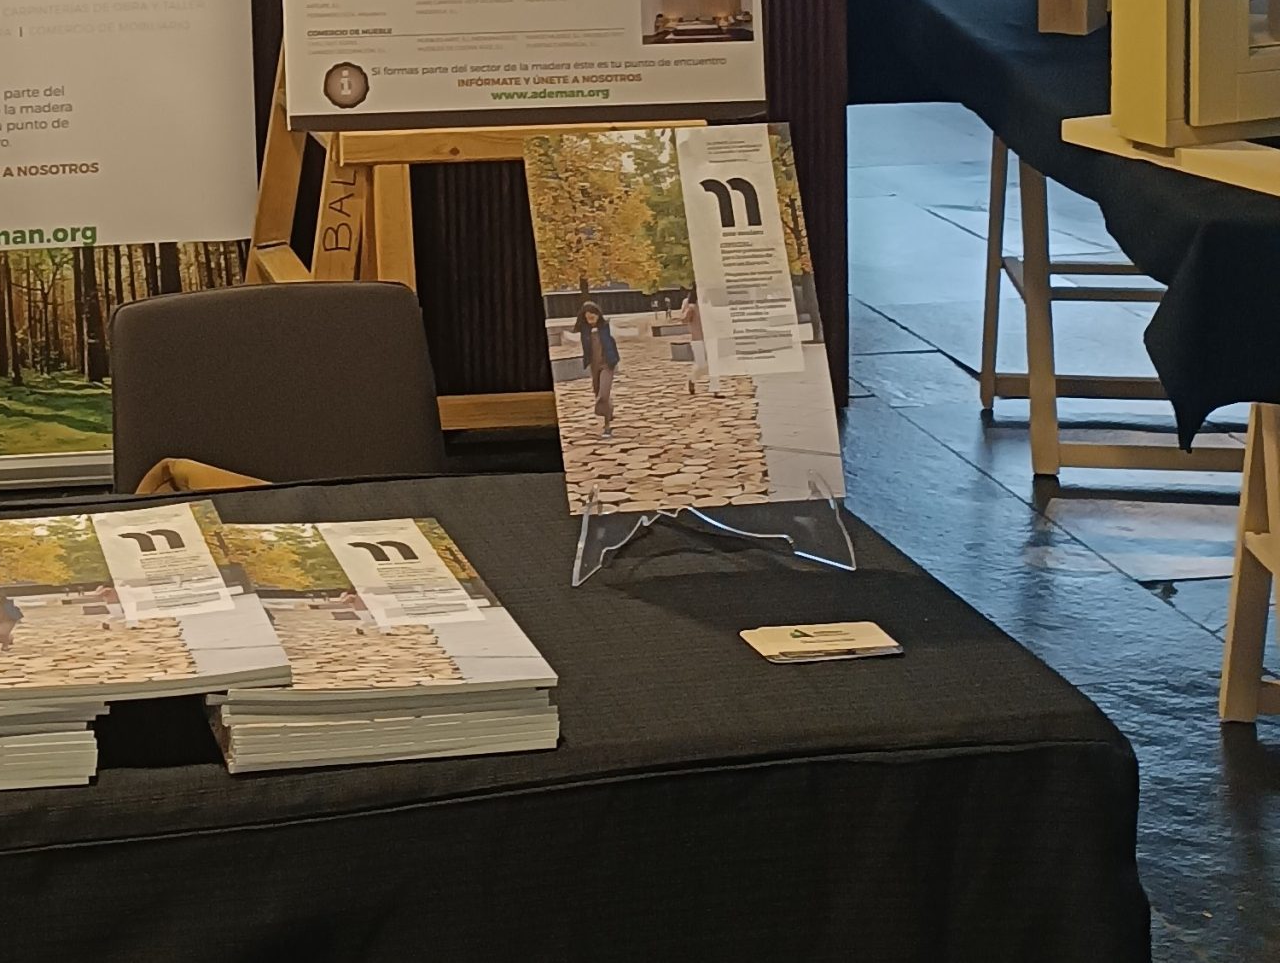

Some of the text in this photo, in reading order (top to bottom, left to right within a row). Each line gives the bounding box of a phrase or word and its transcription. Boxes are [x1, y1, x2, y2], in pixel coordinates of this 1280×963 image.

[371, 67, 380, 76] Si
[384, 67, 419, 75] formas
[422, 67, 448, 75] parte
[451, 65, 467, 73] del
[520, 63, 528, 71] la
[624, 60, 656, 68] punto
[674, 58, 727, 66] encuentro
[458, 76, 521, 87] INFÓRMATE
[523, 78, 531, 86] Y
[533, 75, 569, 84] ÚNETE
[582, 74, 642, 83] NOSOTROS
[4, 89, 39, 101] parte
[43, 86, 64, 97] del
[491, 89, 609, 100] www.ademan.org
[4, 104, 16, 115] la
[20, 103, 72, 114] madera
[7, 120, 48, 133] punto
[51, 118, 69, 129] de
[3, 167, 14, 177] A
[17, 163, 99, 176] NOSOTROS
